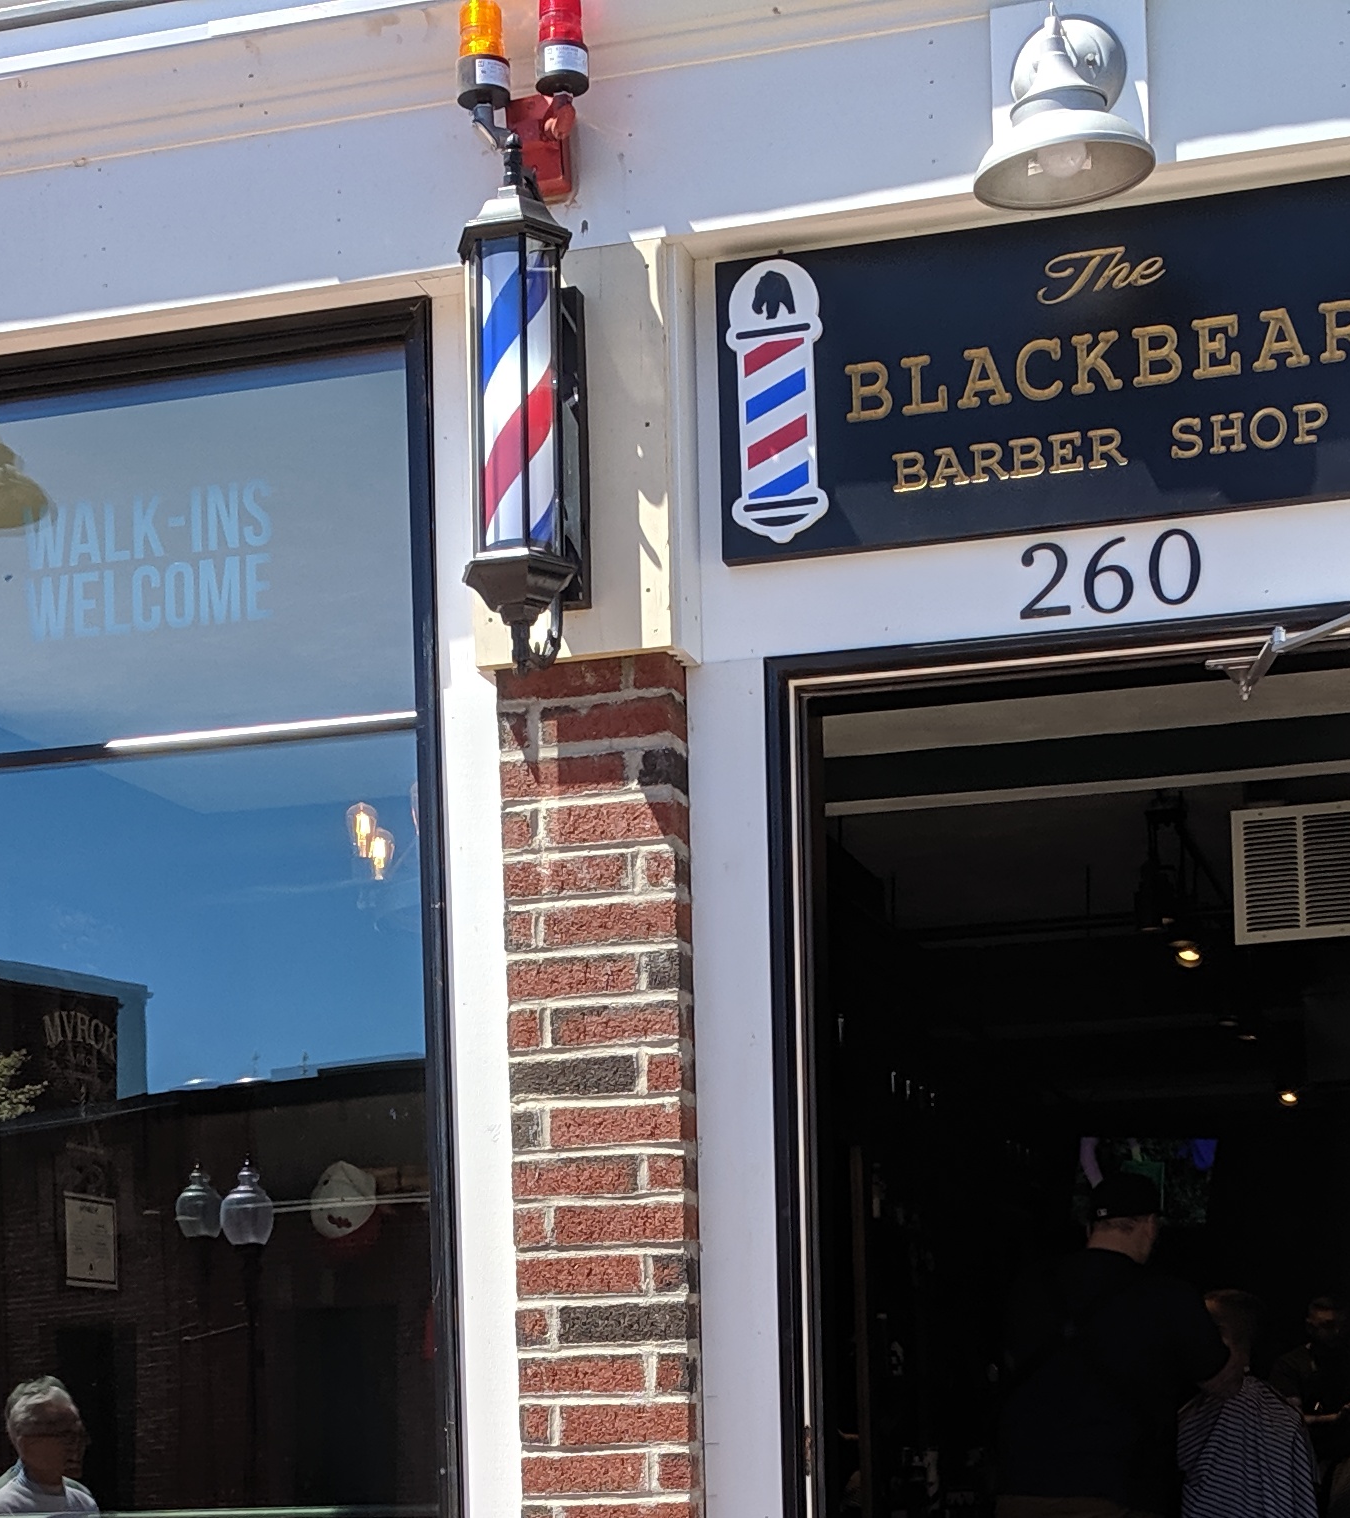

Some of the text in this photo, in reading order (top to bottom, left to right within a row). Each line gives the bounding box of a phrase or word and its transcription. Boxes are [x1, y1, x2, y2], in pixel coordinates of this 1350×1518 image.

[1036, 245, 1165, 305] The
[891, 402, 1328, 494] BARBER SHOP
[23, 478, 272, 572] WALK-INS
[26, 553, 273, 643] WELCOME
[1019, 528, 1202, 621] 260
[42, 1010, 118, 1061] MVRCK
